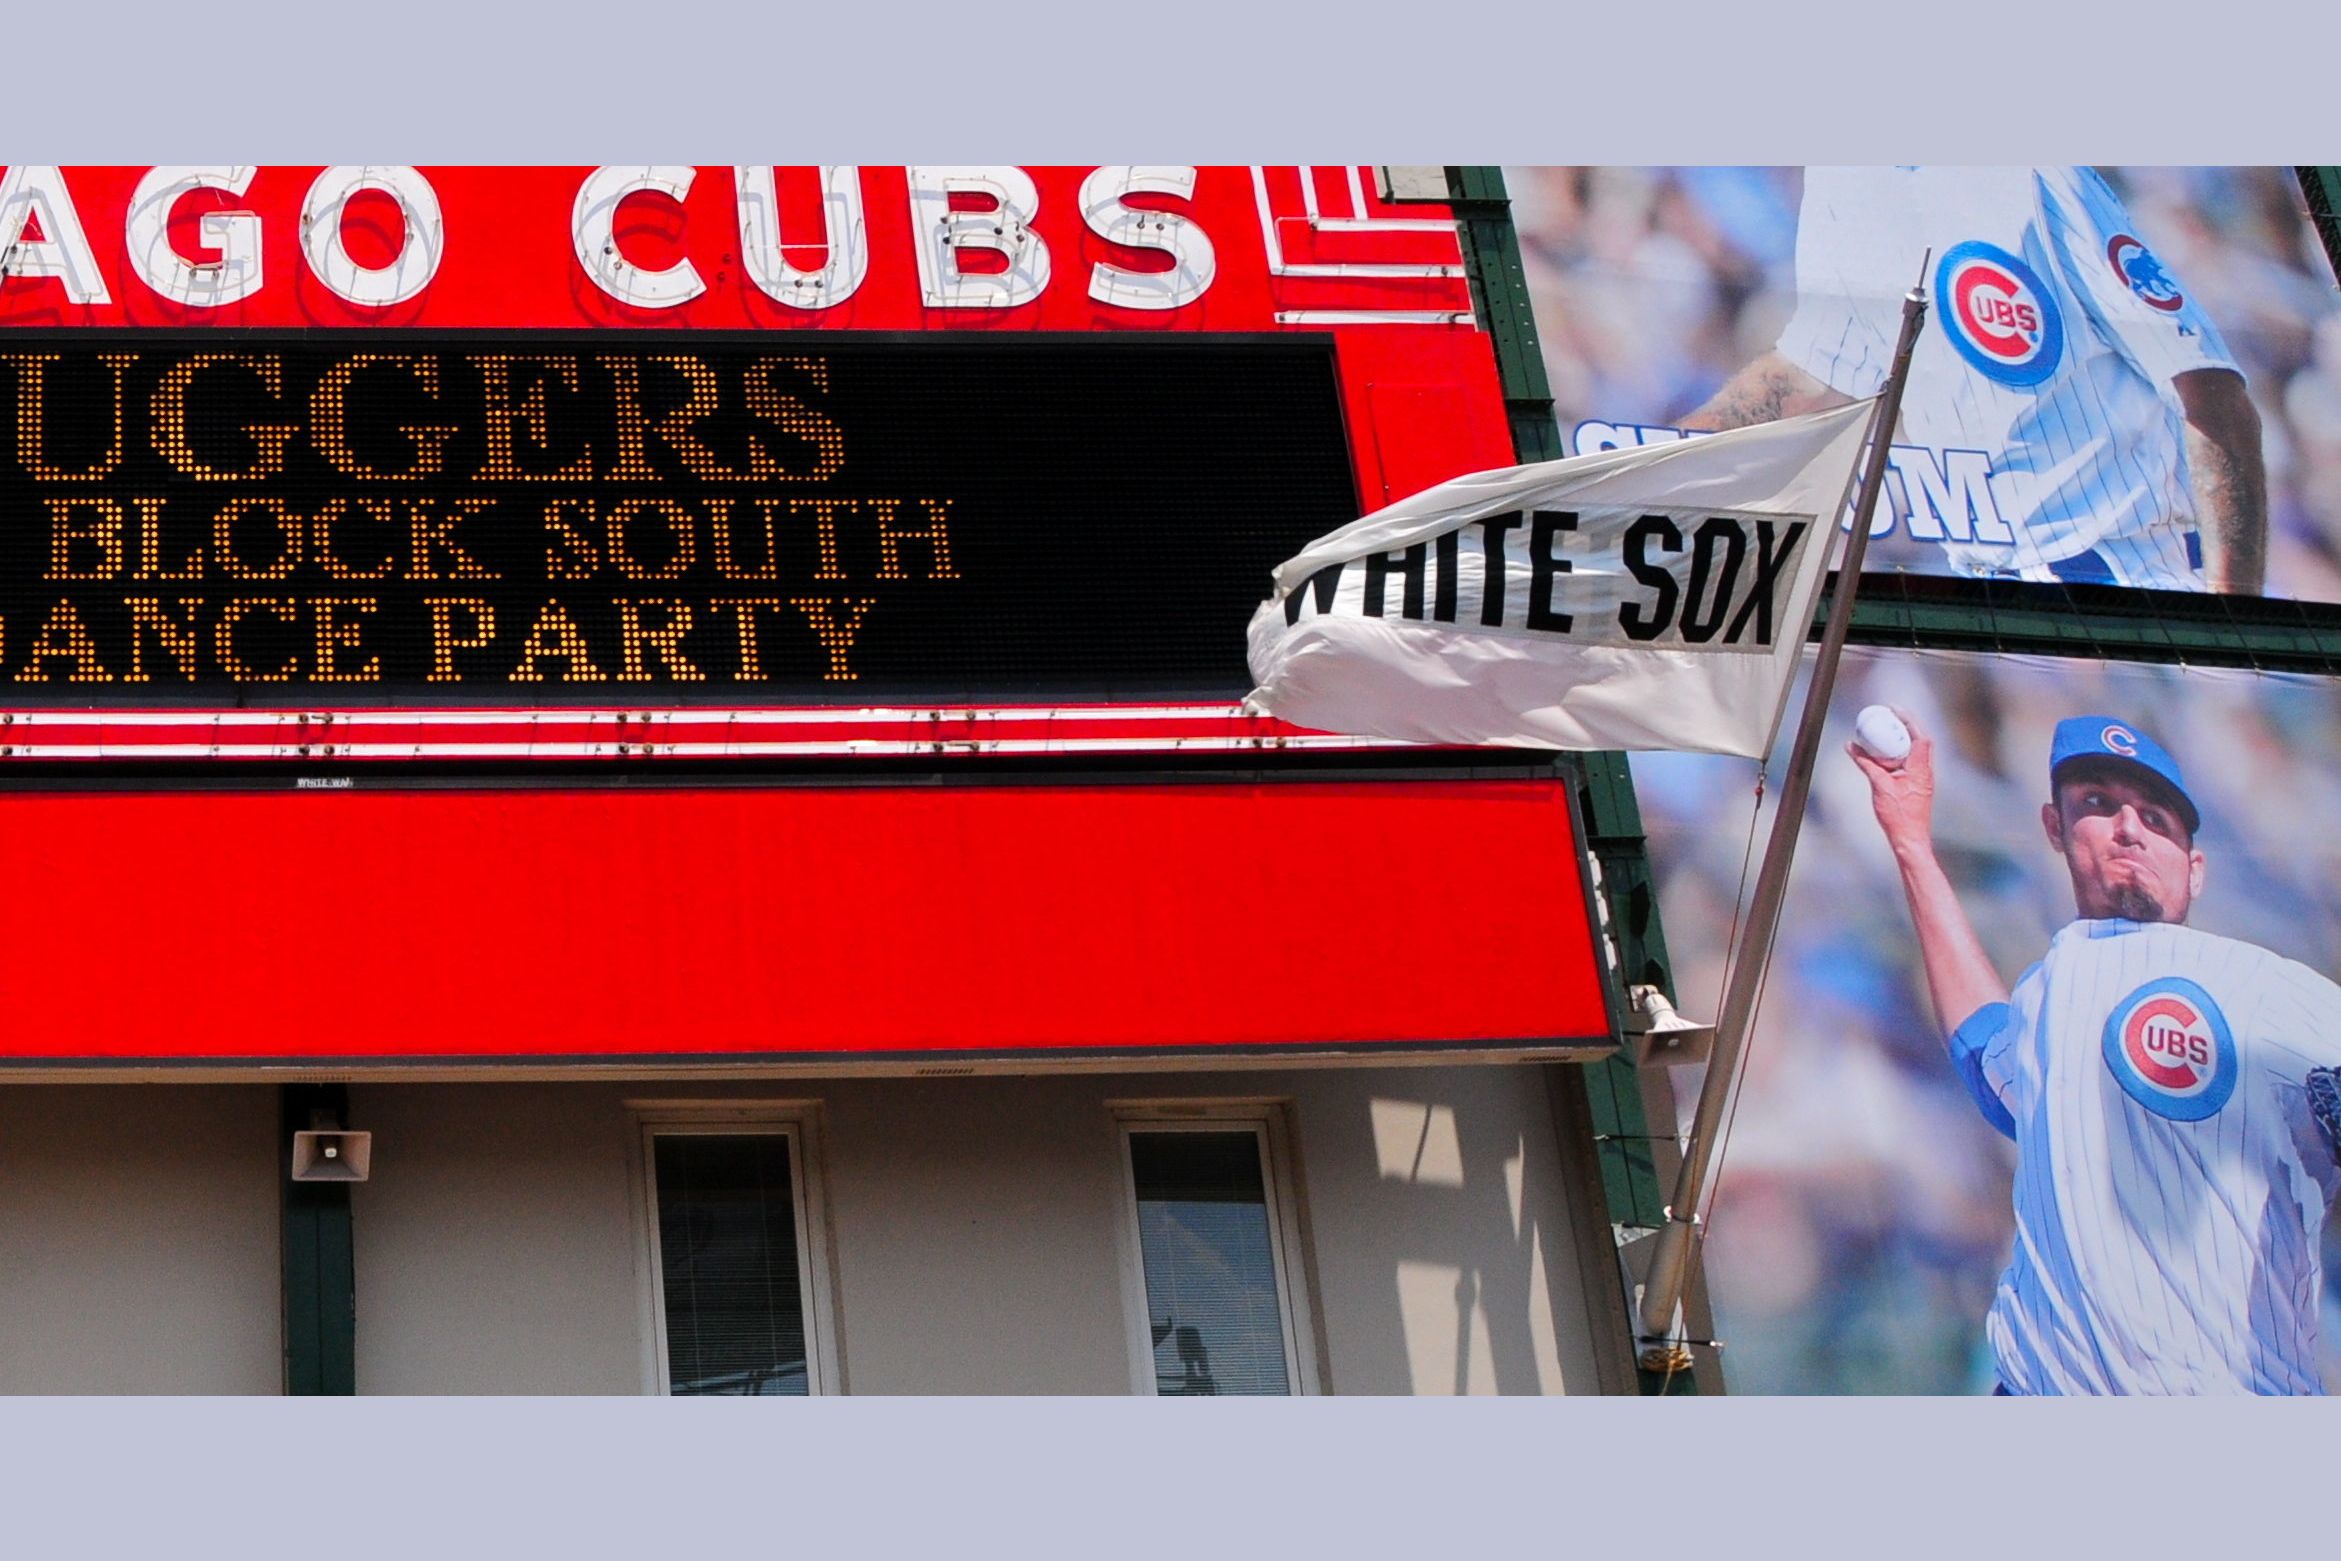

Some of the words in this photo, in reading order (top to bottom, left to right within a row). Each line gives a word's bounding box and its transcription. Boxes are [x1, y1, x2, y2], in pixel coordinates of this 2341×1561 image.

[0, 165, 444, 308] AGO
[571, 165, 1217, 310] CUBS
[0, 354, 846, 481] UGGERS
[43, 498, 501, 580] BLOCK
[544, 498, 962, 580] SOUTH
[1617, 514, 1809, 646] SOX
[0, 597, 381, 682] ANCE
[424, 597, 878, 682] PARTY
